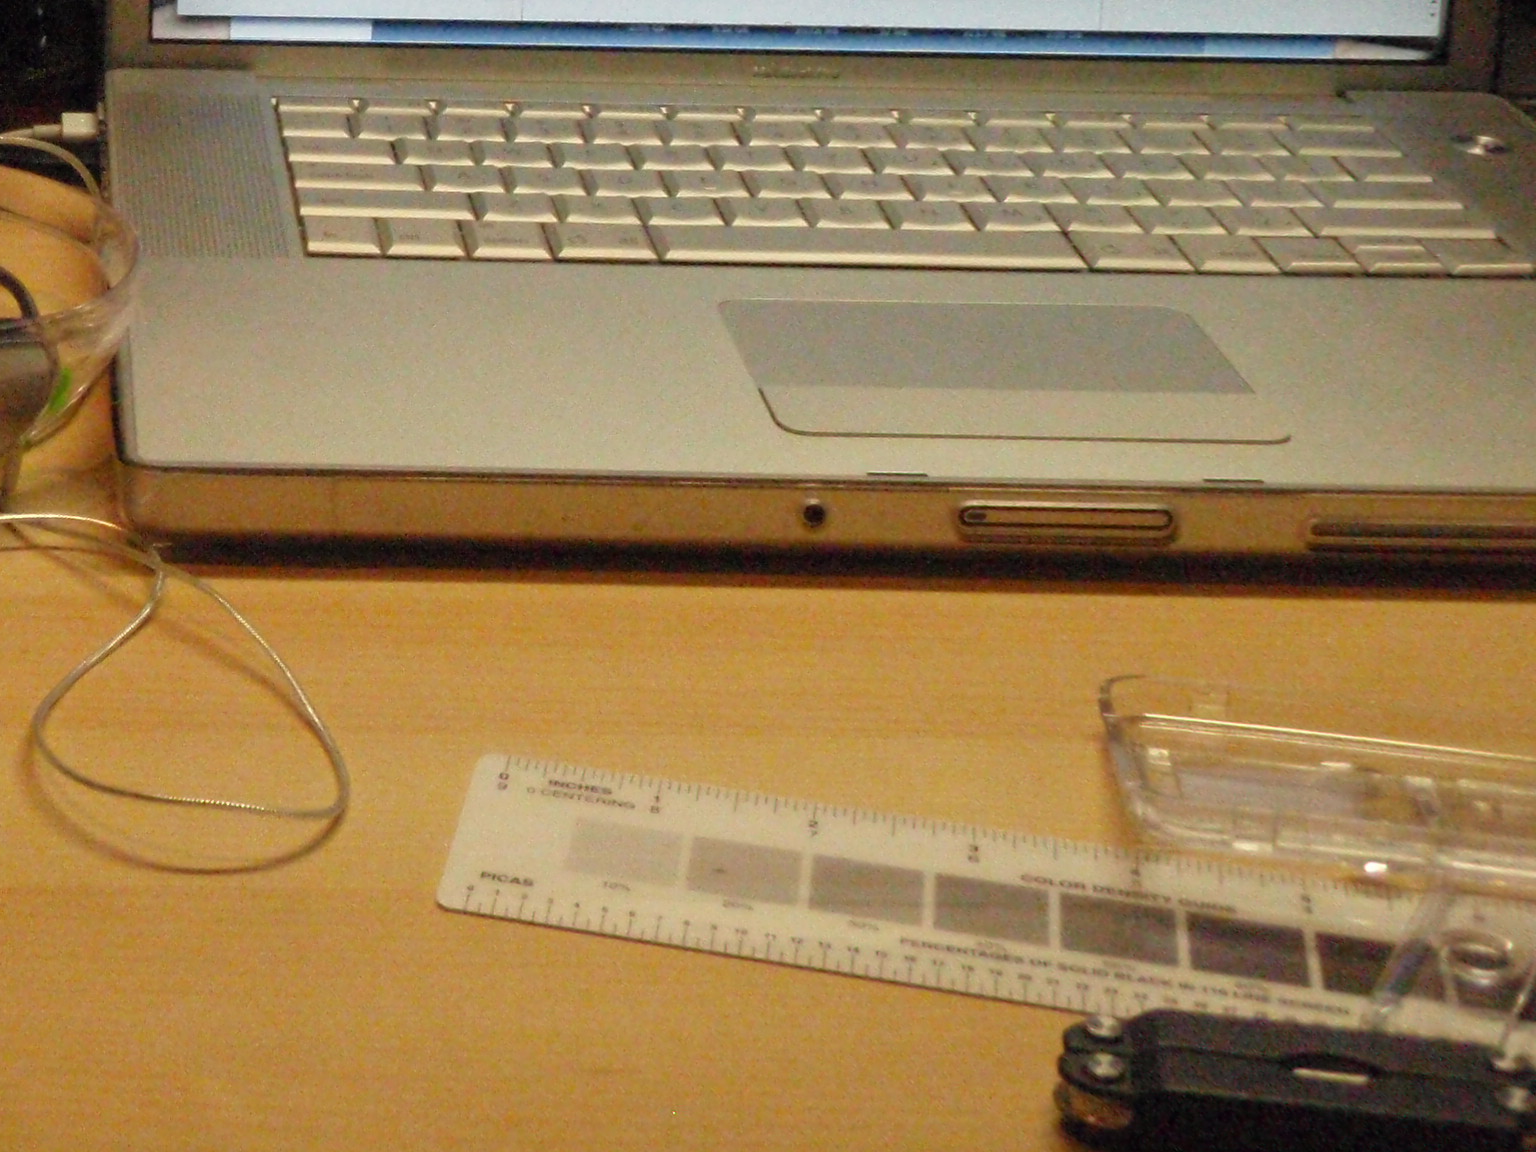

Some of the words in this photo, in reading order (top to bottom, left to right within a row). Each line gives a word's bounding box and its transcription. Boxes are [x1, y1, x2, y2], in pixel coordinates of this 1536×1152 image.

[548, 779, 612, 795] INCHES
[540, 789, 636, 810] CENTERING
[480, 871, 534, 887] PICAS
[1020, 873, 1086, 891] COLOR
[1092, 883, 1172, 903] DENSITY
[900, 936, 1024, 965] PERCENTAGES
